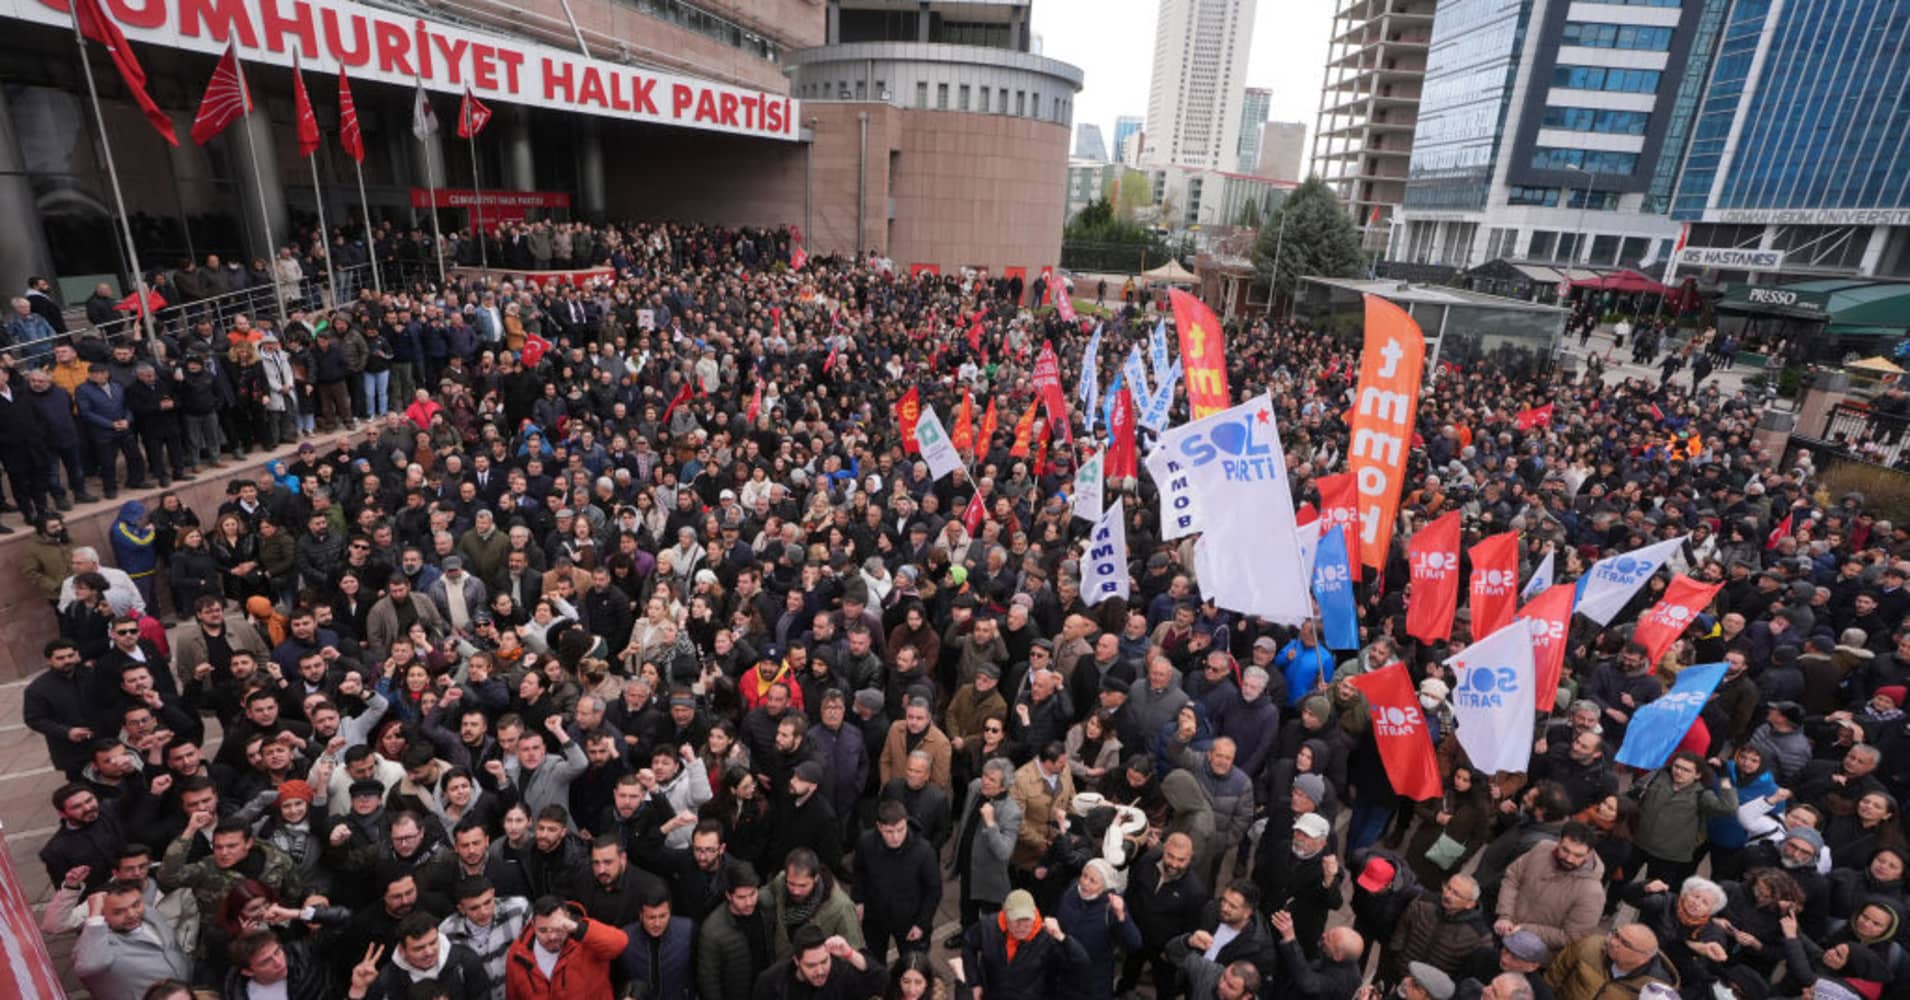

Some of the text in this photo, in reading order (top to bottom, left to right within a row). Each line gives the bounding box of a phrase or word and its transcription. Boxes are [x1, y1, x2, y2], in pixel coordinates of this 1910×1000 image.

[37, 0, 792, 134] MHURİYET HALK PARTİSİ
